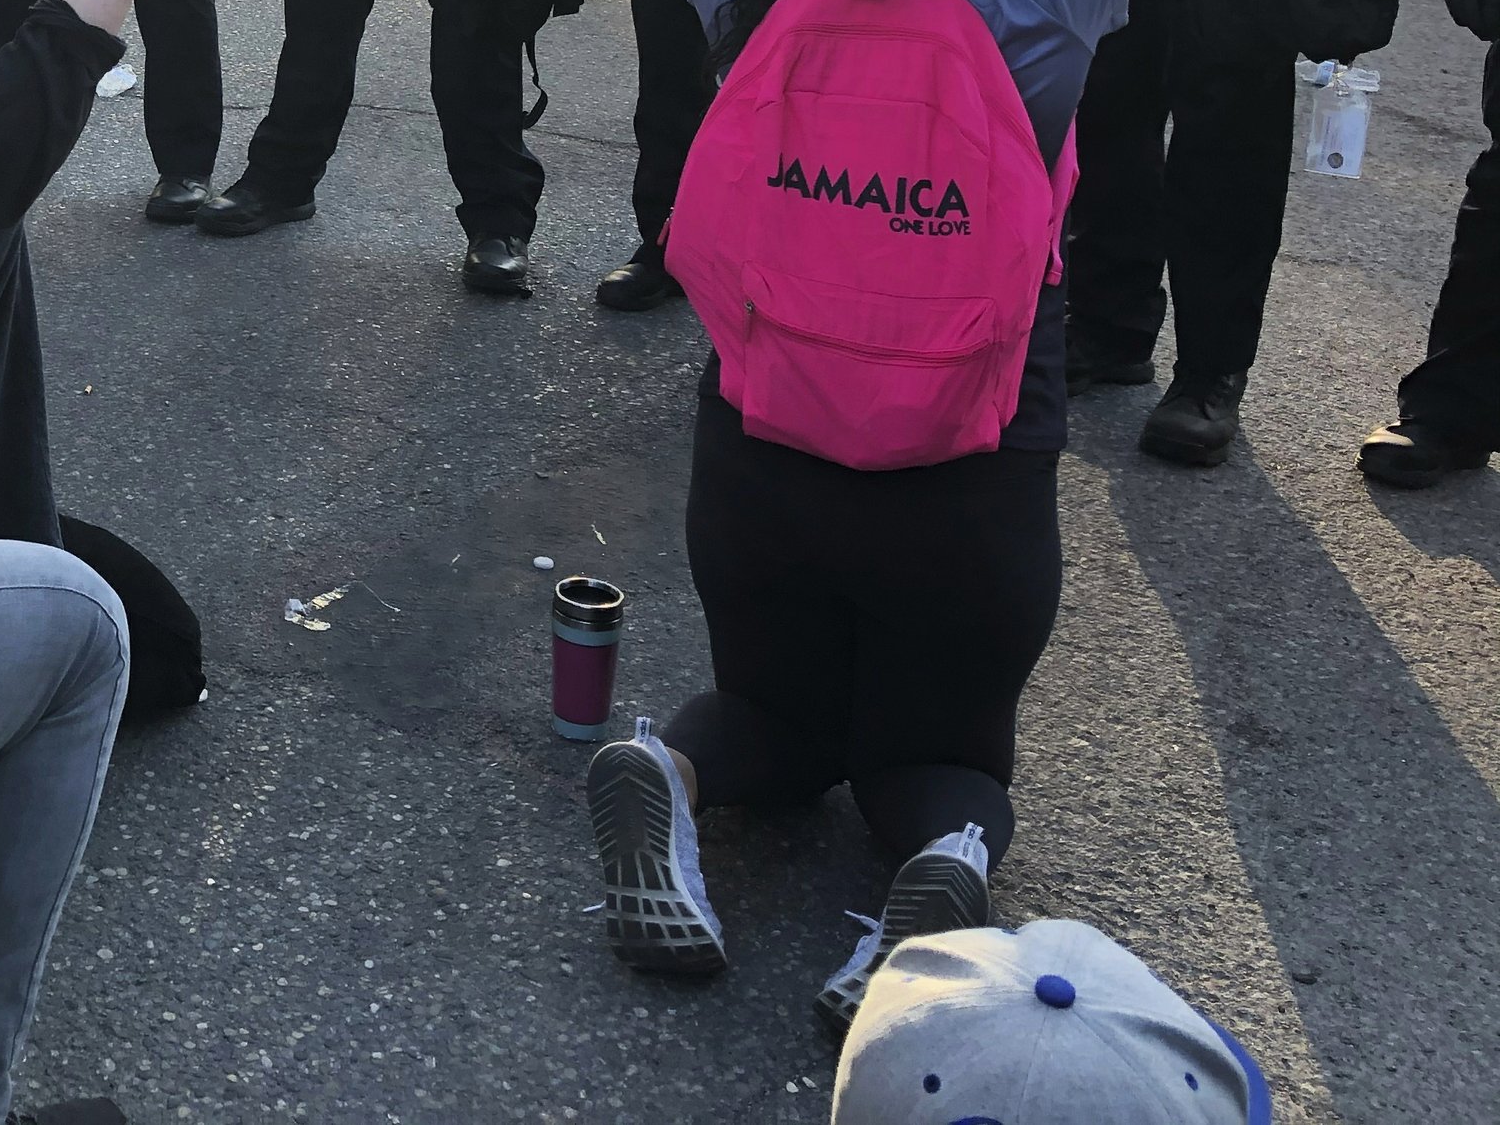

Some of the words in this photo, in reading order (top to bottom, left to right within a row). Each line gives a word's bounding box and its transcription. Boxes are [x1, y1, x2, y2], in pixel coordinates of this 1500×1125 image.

[767, 152, 970, 219] JAMAICA
[889, 217, 925, 235] ONE
[928, 220, 972, 237] LOVE
